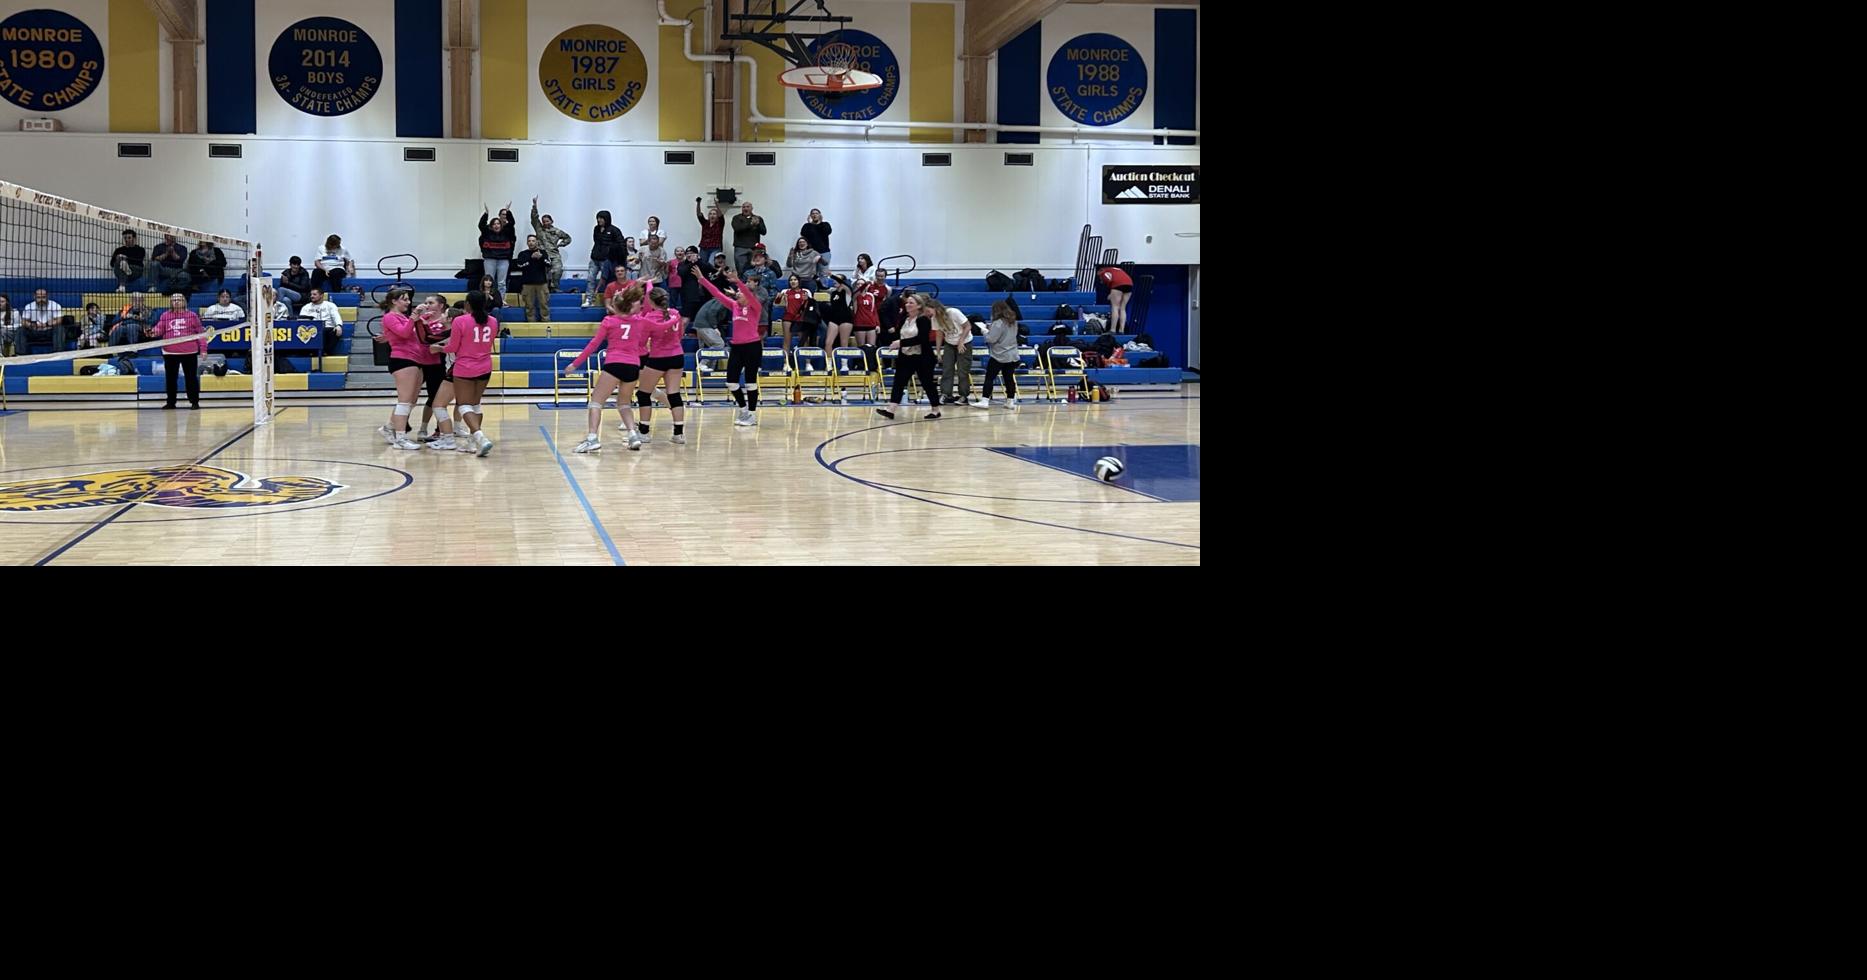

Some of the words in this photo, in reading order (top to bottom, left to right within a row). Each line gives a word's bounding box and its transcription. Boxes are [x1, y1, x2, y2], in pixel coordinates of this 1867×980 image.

[2, 27, 82, 42] MONROE
[294, 28, 358, 43] MONROE
[560, 39, 627, 53] MONROE
[10, 48, 75, 70] 1980
[301, 48, 351, 67] 2014
[1067, 48, 1129, 61] MONROE
[571, 55, 620, 74] 1987
[307, 72, 345, 84] BOYS
[1077, 64, 1120, 81] 1988
[42, 60, 98, 106] CHAMPS
[572, 78, 616, 91] GIRLS
[1077, 84, 1119, 96] GIRLS
[292, 92, 331, 113] STATE
[336, 75, 377, 112] CHAMPS
[300, 85, 353, 100] UNDEFEATED
[545, 79, 583, 116] STATE
[589, 80, 642, 119] CHAMPS
[841, 105, 876, 120] STATE
[877, 64, 897, 107] CHAMPS
[1052, 86, 1088, 120] STATE
[1093, 87, 1143, 123] CHAMPS
[1109, 172, 1148, 181] Auction
[1149, 172, 1195, 181] Checkout
[1148, 185, 1190, 193] DENALI
[221, 328, 241, 342] GO
[245, 327, 292, 342] RS!
[473, 326, 491, 343] 12
[620, 324, 631, 340] 7
